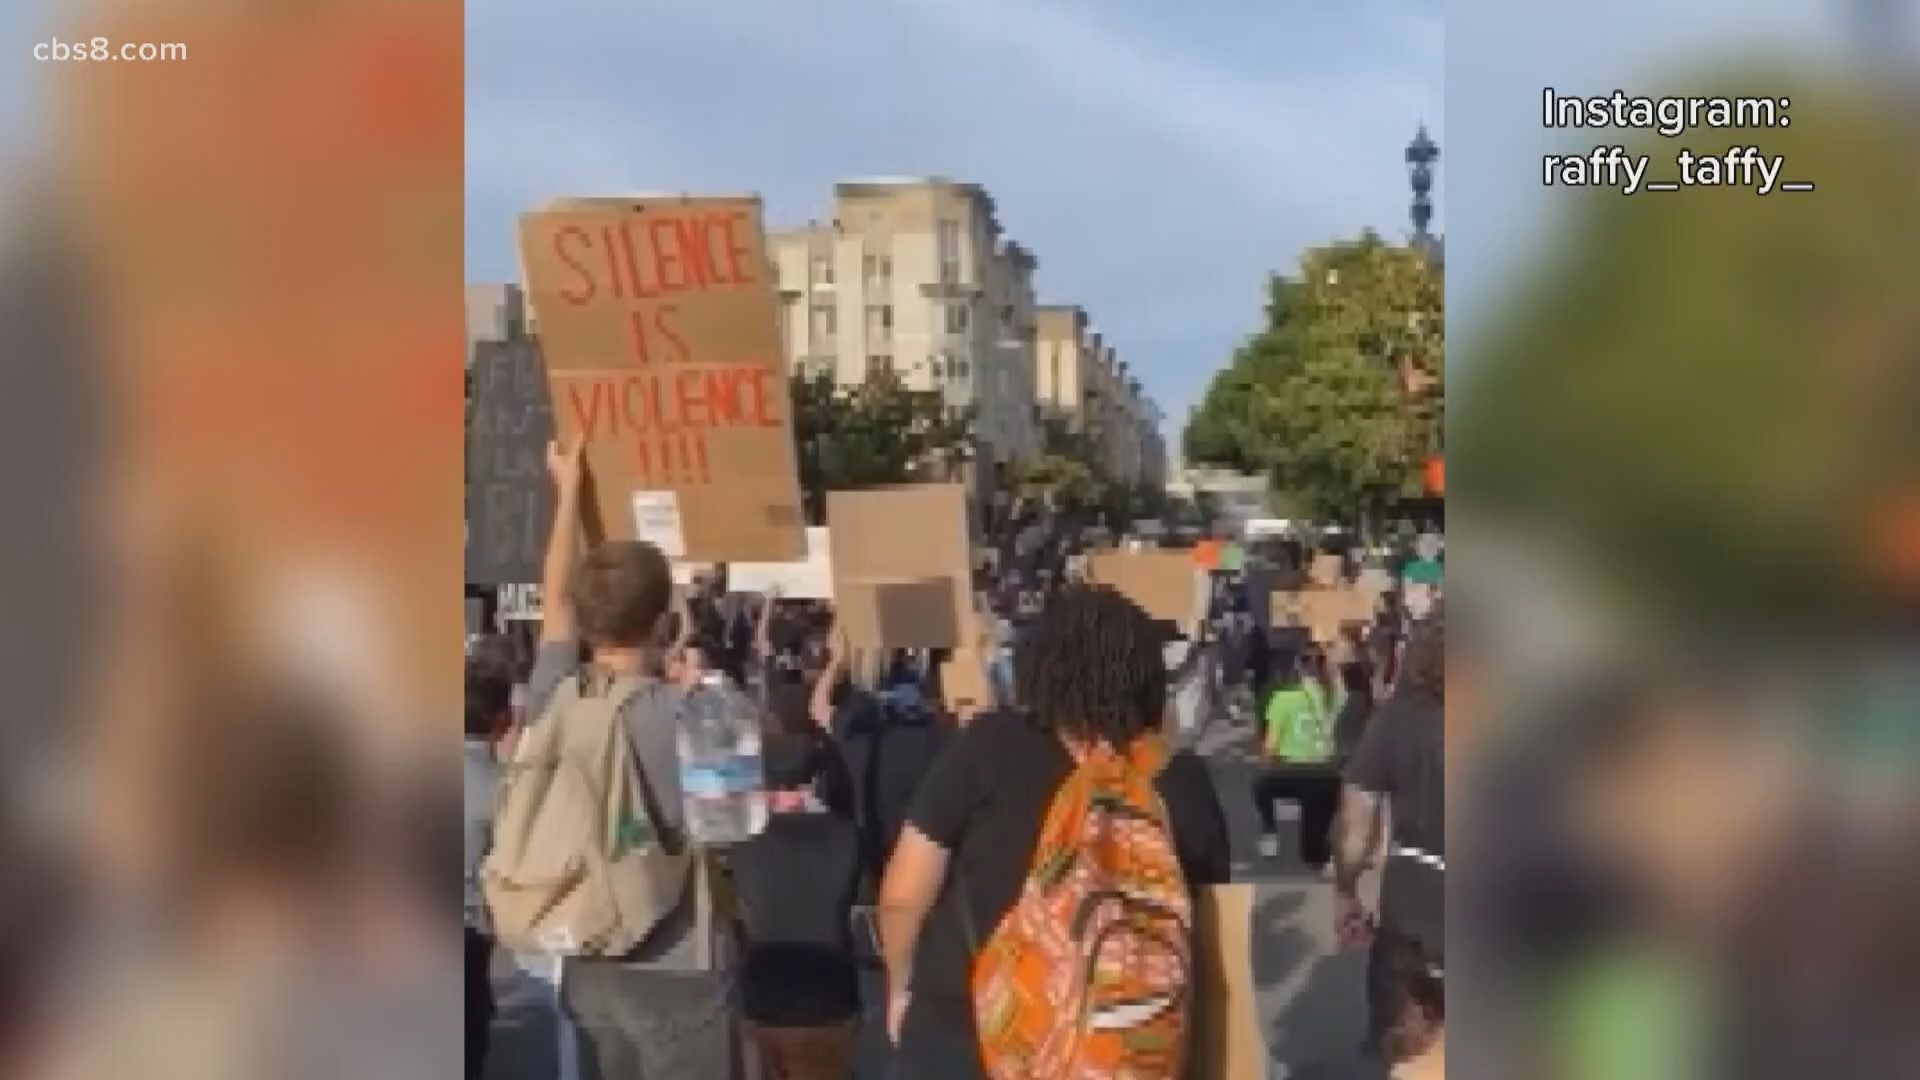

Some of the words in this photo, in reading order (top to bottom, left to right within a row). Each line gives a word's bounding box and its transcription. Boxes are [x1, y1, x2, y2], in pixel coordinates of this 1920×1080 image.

[554, 211, 757, 306] SILENCE
[631, 304, 692, 364] IS
[568, 367, 784, 442] VIOLENCE
